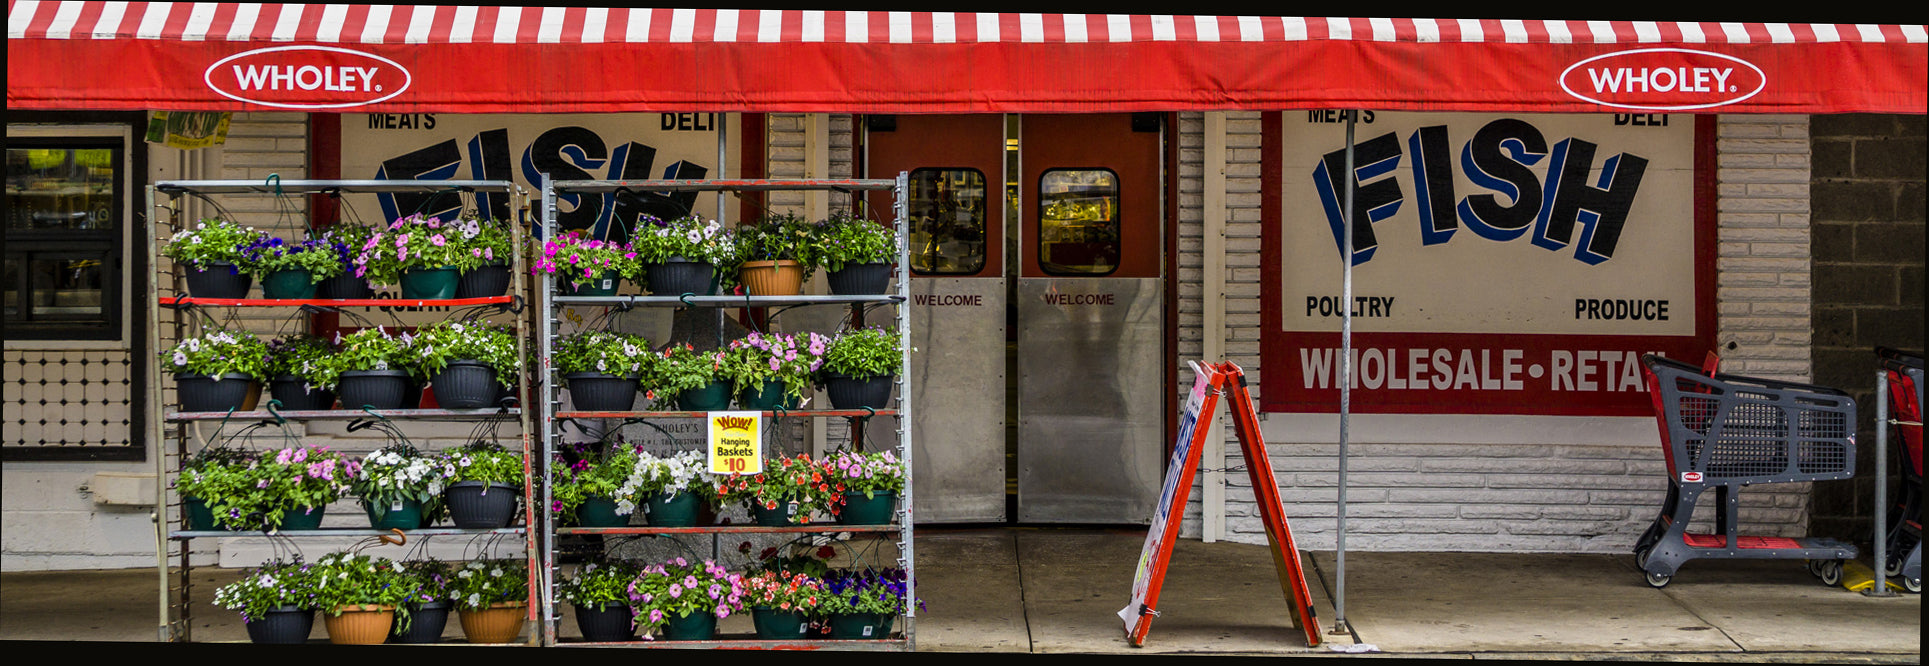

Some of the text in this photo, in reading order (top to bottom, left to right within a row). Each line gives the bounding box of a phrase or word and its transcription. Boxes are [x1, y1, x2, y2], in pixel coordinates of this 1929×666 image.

[233, 65, 379, 92] WHOLEY
[1588, 67, 1733, 93] WHOLEY
[661, 112, 714, 131] DELI
[1308, 109, 1376, 124] MEAS
[1614, 113, 1669, 127] DELI
[375, 126, 708, 248] FISH
[1312, 118, 1649, 266] FISH
[915, 294, 982, 306] WELCOME
[1045, 293, 1115, 306] WELCOME
[1575, 298, 1669, 321] PRODUCE
[1551, 350, 1666, 393] RETA
[721, 438, 750, 447] Hanging
[717, 447, 753, 456] Baskets
[724, 457, 746, 472] $10
